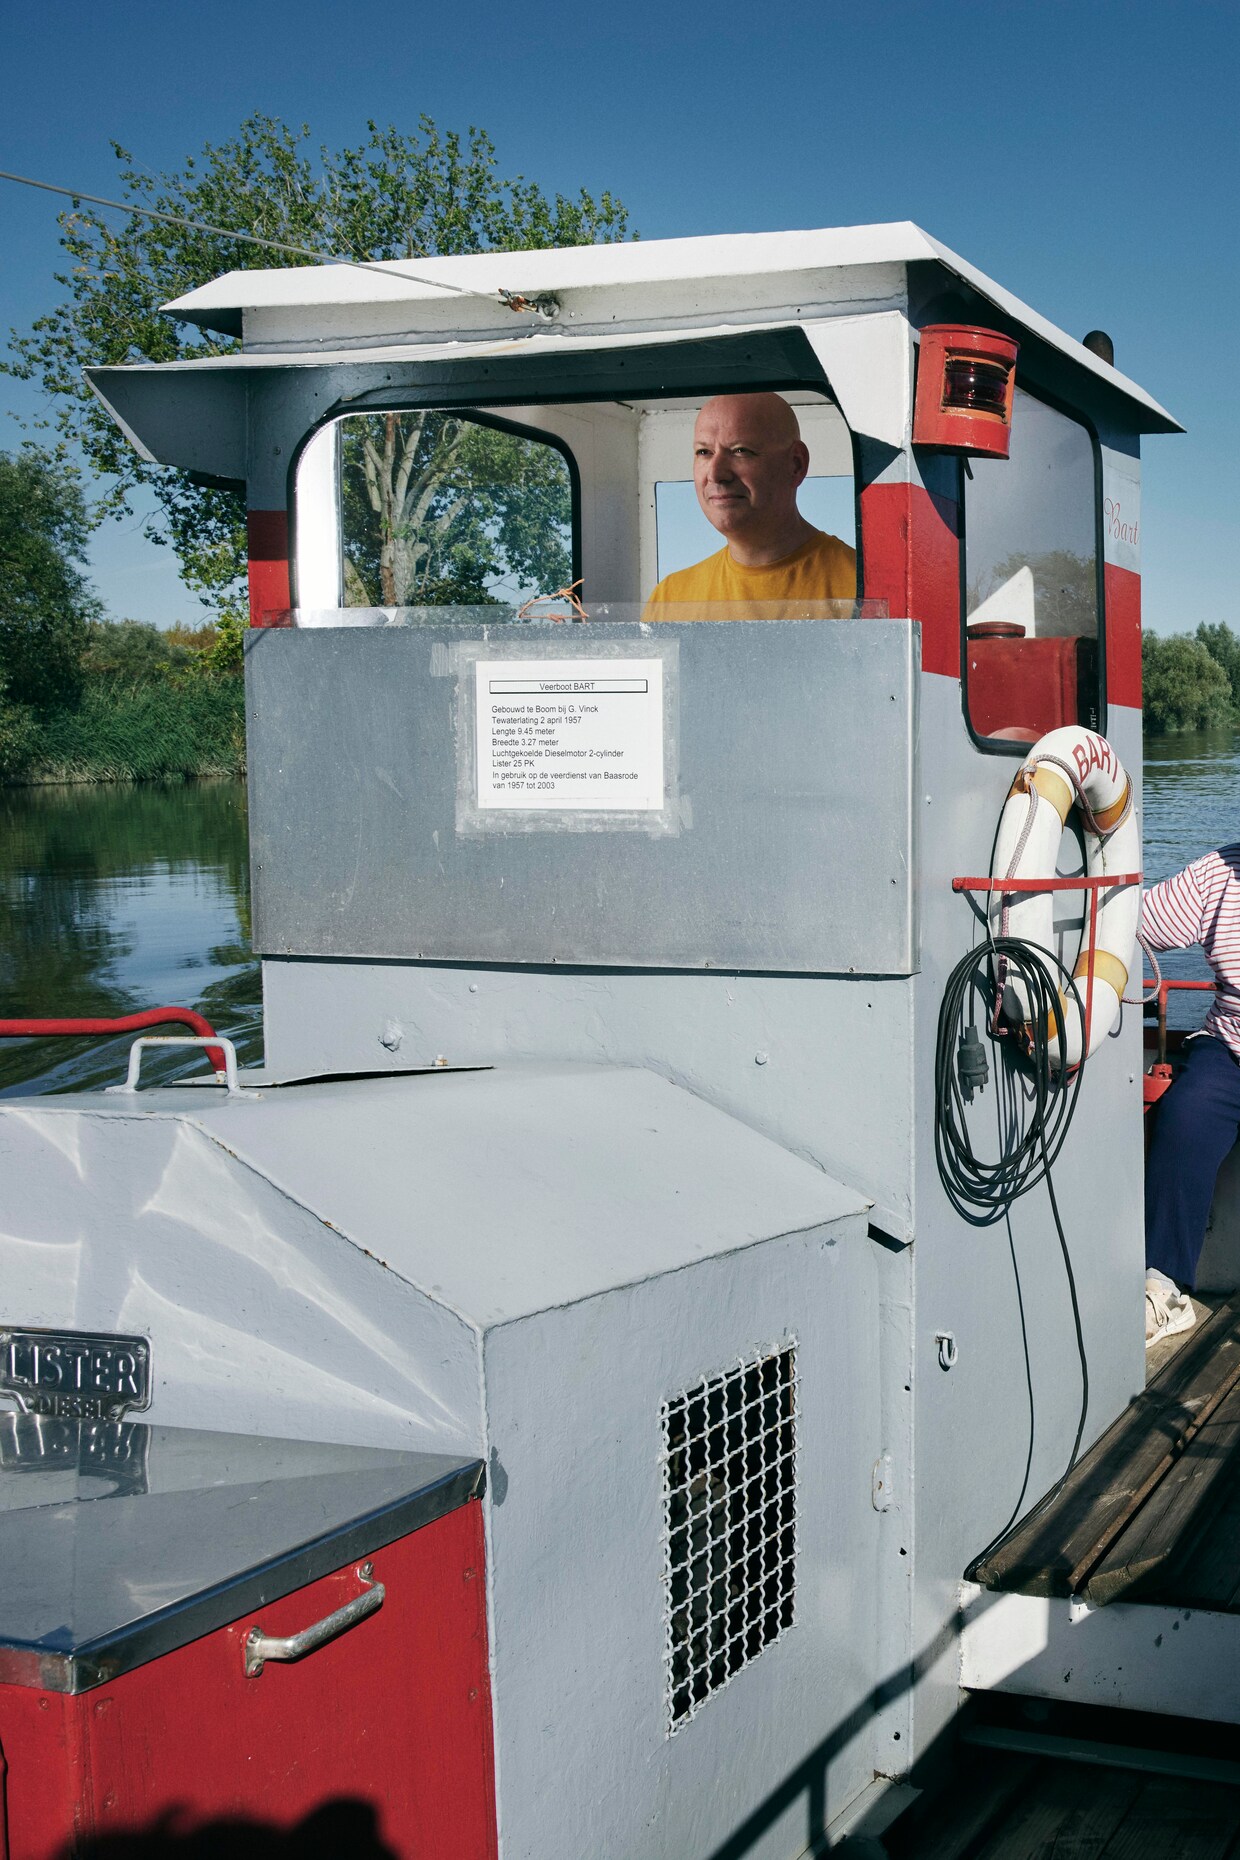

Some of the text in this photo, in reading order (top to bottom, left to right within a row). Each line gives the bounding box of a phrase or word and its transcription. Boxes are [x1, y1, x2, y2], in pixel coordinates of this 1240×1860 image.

[1104, 497, 1138, 545] Bart
[492, 705, 525, 713] Gebouwd
[536, 705, 556, 713] Boom
[558, 705, 566, 714] bij
[568, 705, 576, 713] G.
[492, 716, 581, 725] Tewaterlating 2 april 1957
[492, 728, 516, 737] Lengte
[492, 749, 624, 759] Luchtgekoelde Dieselmotor 2-cylinder
[501, 771, 526, 780] gebruik
[9, 1343, 138, 1394] LISTER
[37, 1392, 107, 1420] DIESEL
